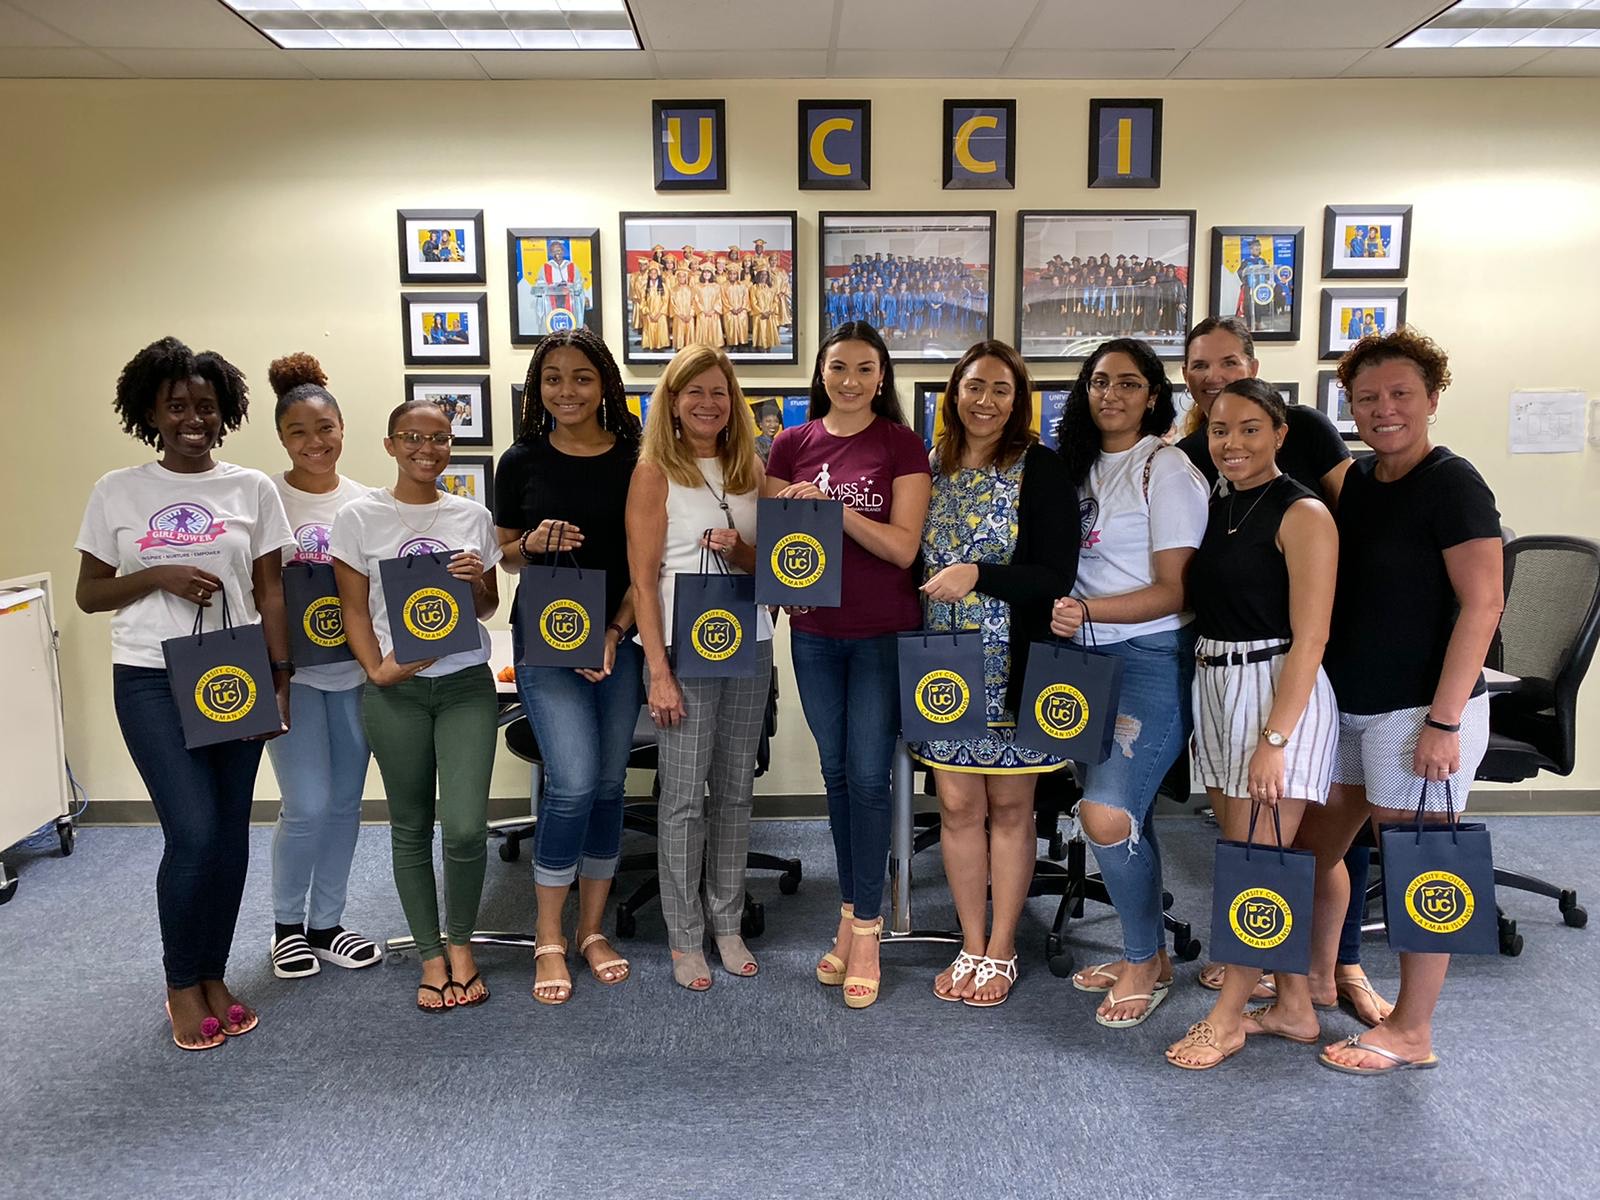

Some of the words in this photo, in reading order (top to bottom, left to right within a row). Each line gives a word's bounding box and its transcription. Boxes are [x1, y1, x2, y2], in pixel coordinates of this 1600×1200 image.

[667, 116, 712, 175] U
[809, 117, 854, 176] C
[955, 115, 998, 174] C
[1117, 118, 1133, 175] I
[826, 482, 859, 496] MISS
[152, 531, 175, 539] GIRL
[176, 533, 213, 542] POWER
[773, 535, 801, 556] UNIVERSITY
[801, 535, 824, 556] COLLEGE
[299, 552, 320, 560] GIRL
[788, 557, 808, 570] UC
[775, 570, 804, 586] CAYMAN
[804, 563, 824, 585] ISLANDS
[404, 589, 429, 614] UNIVERSITY
[430, 589, 455, 606] COLLEGE
[320, 619, 339, 630] UC
[410, 627, 442, 639] CAYMAN
[442, 611, 458, 636] ISLANDS
[421, 610, 441, 624] UC
[556, 622, 574, 633] UC
[707, 632, 726, 644] UC
[195, 668, 224, 696] UNIVERSITY
[225, 667, 253, 685] COLLEGE
[916, 671, 943, 695] UNIVERSITY
[944, 671, 968, 690] COLLEGE
[203, 708, 238, 721] CAYMAN
[237, 690, 256, 717] ISLANDS
[215, 690, 237, 704] UC
[932, 693, 952, 706] UC
[1037, 685, 1066, 703] UNIVERSITY
[1067, 687, 1088, 711] COLLEGE
[920, 708, 950, 722] CAYMAN
[950, 697, 969, 720] ISLANDS
[1051, 707, 1071, 721] UC
[1037, 718, 1064, 737] CAYMAN
[1065, 718, 1087, 737] ISLANDS
[1406, 873, 1439, 898] UNIVERSITY
[1441, 873, 1472, 897] COLLEGE
[1231, 889, 1264, 912] UNIVERSITY
[1264, 891, 1292, 917] COLLEGE
[1427, 898, 1451, 912] UC
[1249, 914, 1271, 929] UC
[1412, 913, 1449, 931] CAYMAN
[1450, 904, 1474, 929] ISLANDS
[1233, 927, 1266, 947] CAYMAN
[1267, 923, 1292, 946] ISLANDS
